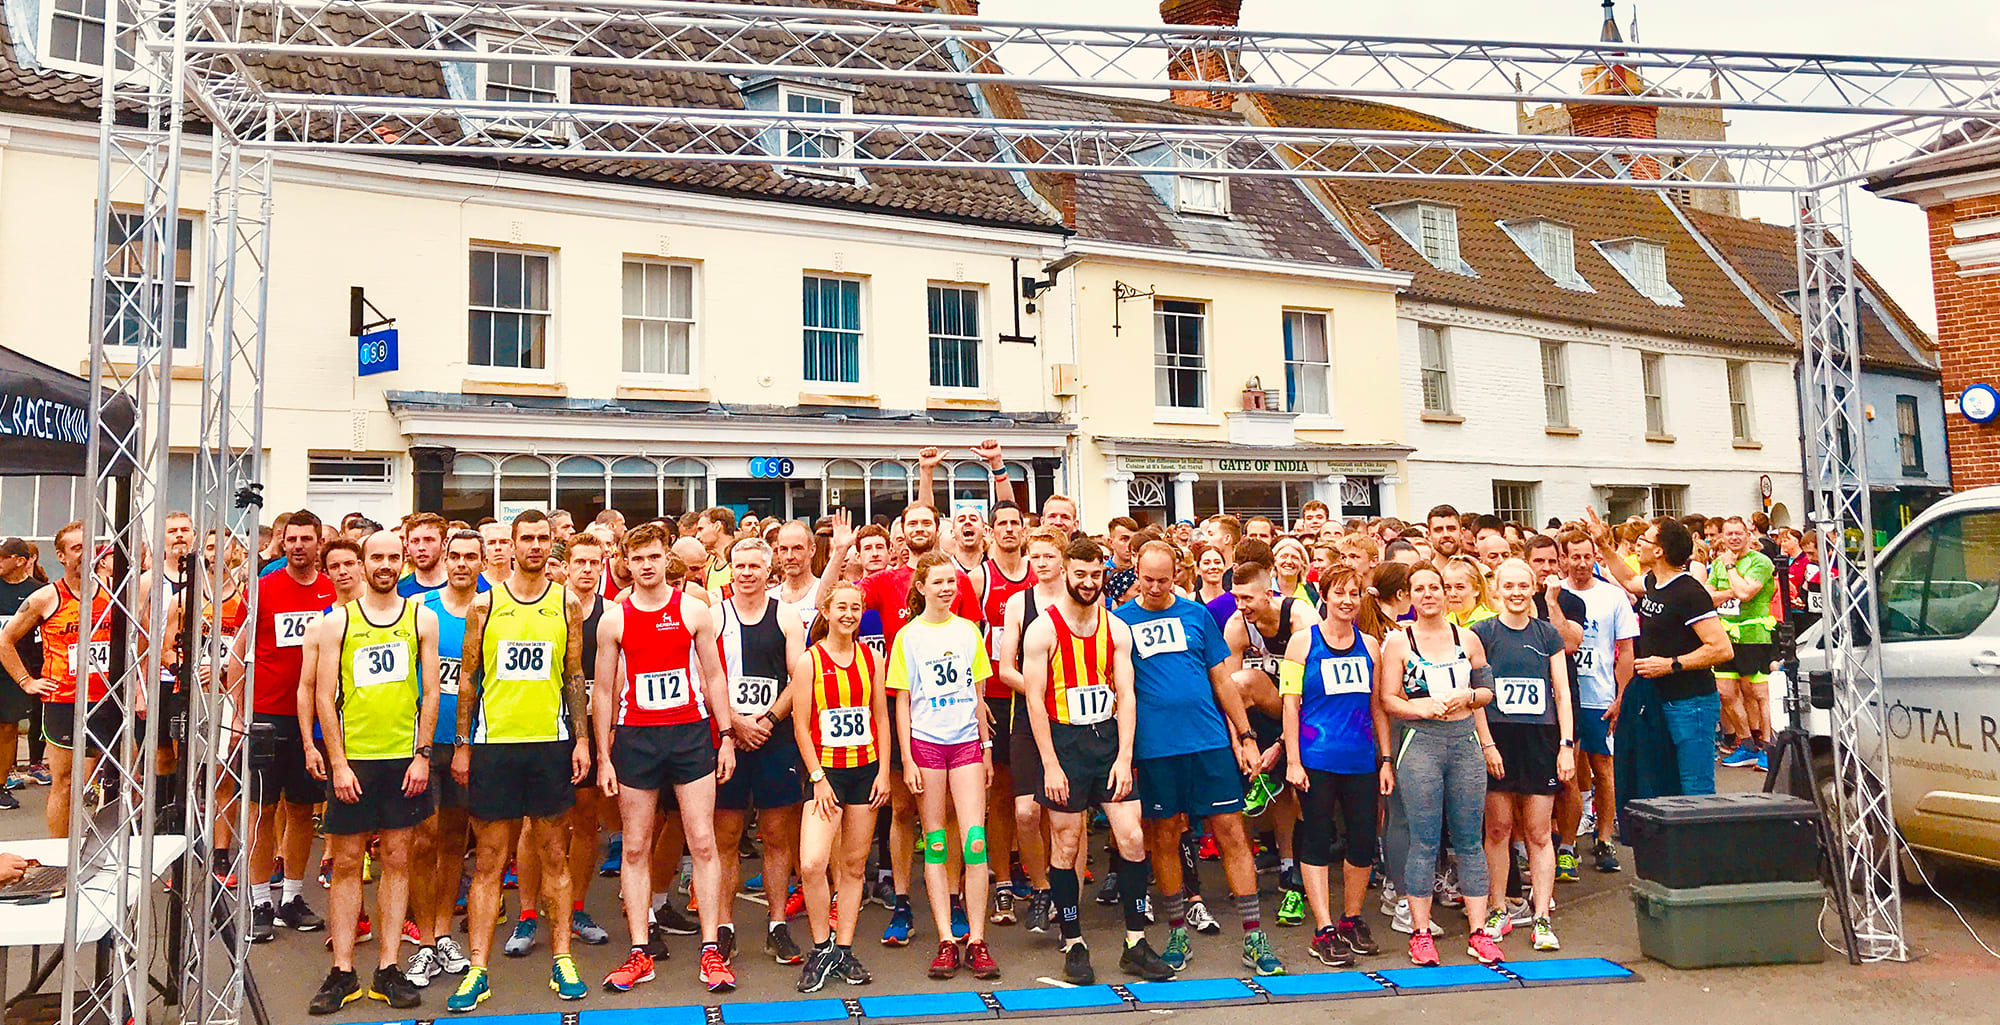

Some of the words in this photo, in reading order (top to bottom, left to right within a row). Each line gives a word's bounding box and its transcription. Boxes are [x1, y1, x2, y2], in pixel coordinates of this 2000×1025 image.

[362, 343, 386, 361] TSB
[753, 459, 792, 475] TSB
[1219, 459, 1251, 471] GATE
[1254, 459, 1270, 471] OF
[1274, 459, 1309, 472] INDIA
[283, 616, 314, 638] 26
[1142, 623, 1176, 647] 321
[368, 649, 395, 674] 30
[505, 647, 544, 671] 308
[933, 661, 958, 686] 36
[1333, 662, 1362, 685] 121
[1448, 667, 1456, 688] 1
[647, 675, 681, 702] 112
[737, 682, 772, 706] 330
[1503, 684, 1539, 705] 278
[1079, 691, 1108, 716] 117
[830, 713, 865, 738] 358
